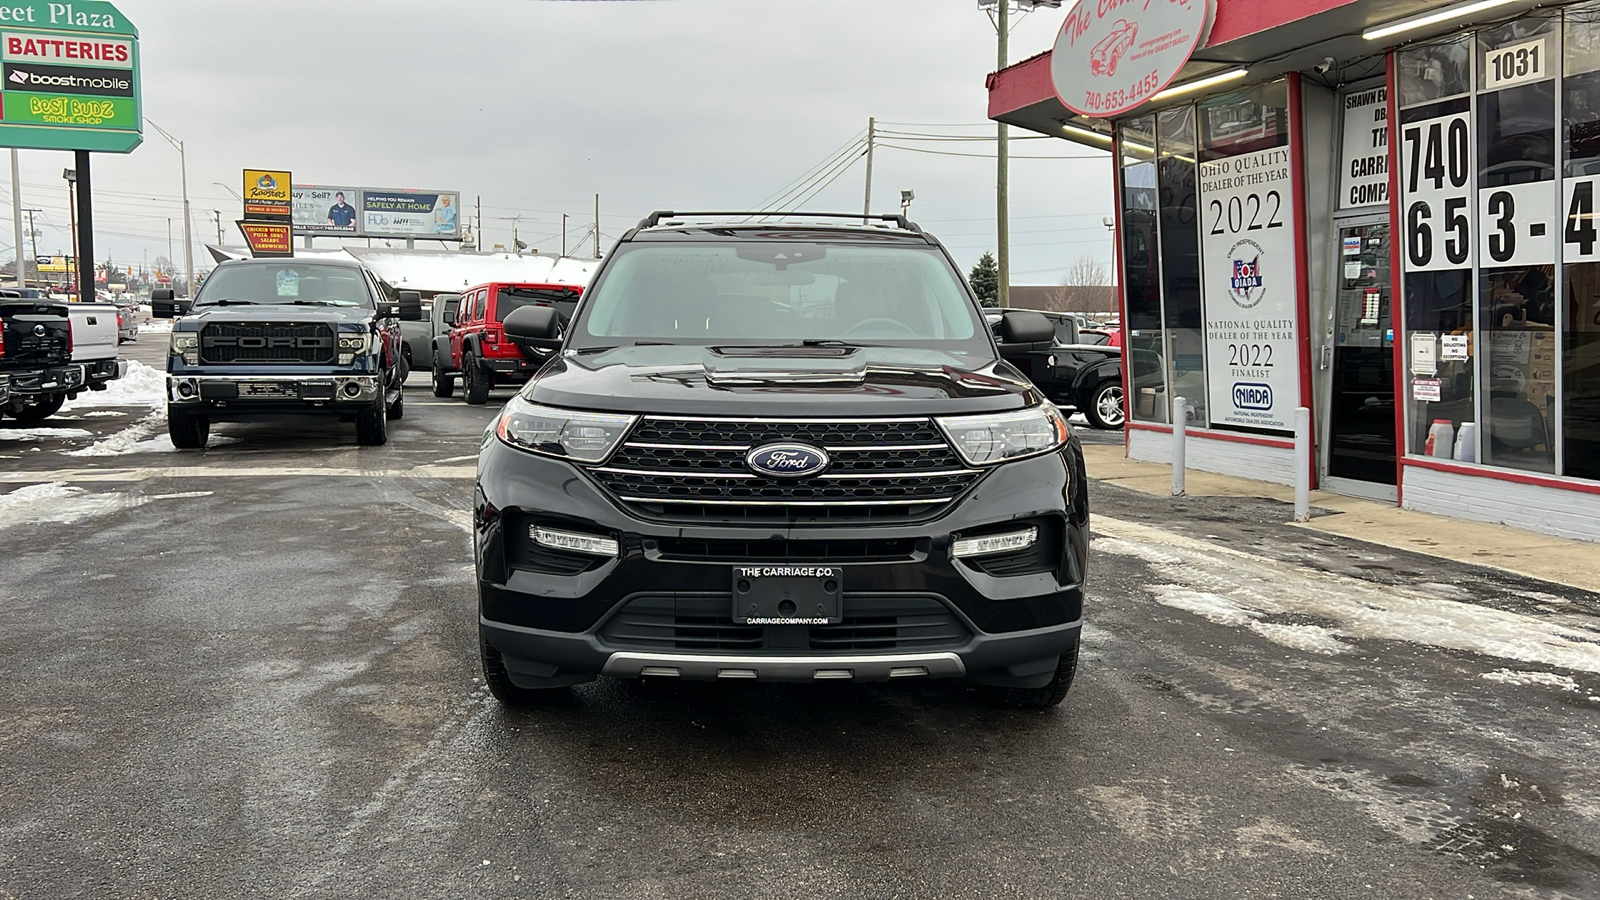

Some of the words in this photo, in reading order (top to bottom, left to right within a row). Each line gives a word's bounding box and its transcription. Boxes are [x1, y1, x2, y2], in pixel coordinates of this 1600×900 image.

[48, 3, 116, 28] Plaza
[1065, 5, 1091, 48] The
[8, 37, 129, 62] BATTERIES
[1491, 45, 1540, 82] 1031
[1084, 69, 1159, 110] 740-653-4455
[70, 98, 115, 119] BUDZ
[1346, 90, 1376, 110] SHAWN
[42, 115, 76, 124] SMOKE
[76, 116, 103, 125] SHOP
[1374, 107, 1388, 122] DB
[1201, 161, 1230, 178] OHIO
[1234, 149, 1290, 174] QUALITY
[1404, 117, 1469, 194] 740
[1202, 177, 1233, 193] DEALER
[1234, 176, 1245, 188] OF
[1246, 173, 1264, 186] THE
[1264, 167, 1289, 183] YEAR
[249, 187, 287, 199] Roosters
[292, 192, 304, 200] uy
[311, 191, 331, 200] Sell?
[366, 201, 394, 209] SAFELY
[407, 203, 432, 211] HOME
[1209, 190, 1283, 235] 2022
[368, 213, 389, 226] Hub
[1234, 278, 1258, 288] OIADA
[1208, 320, 1251, 329] NATIONAL
[1253, 319, 1294, 331] QUALITY
[202, 336, 333, 348] FORD
[1209, 331, 1238, 340] DEALER
[1240, 331, 1250, 340] OF
[1253, 332, 1269, 340] THE
[1271, 332, 1293, 340] YEAR
[1228, 343, 1274, 367] 2022
[1231, 368, 1270, 379] FINALIST
[1235, 388, 1269, 405] NIADA
[766, 450, 810, 469] Ford
[740, 567, 761, 577] THE
[763, 567, 815, 577] CARRIAGE
[816, 567, 834, 577] CO.
[746, 617, 829, 626] CARRIAGECOMPANY.COM
